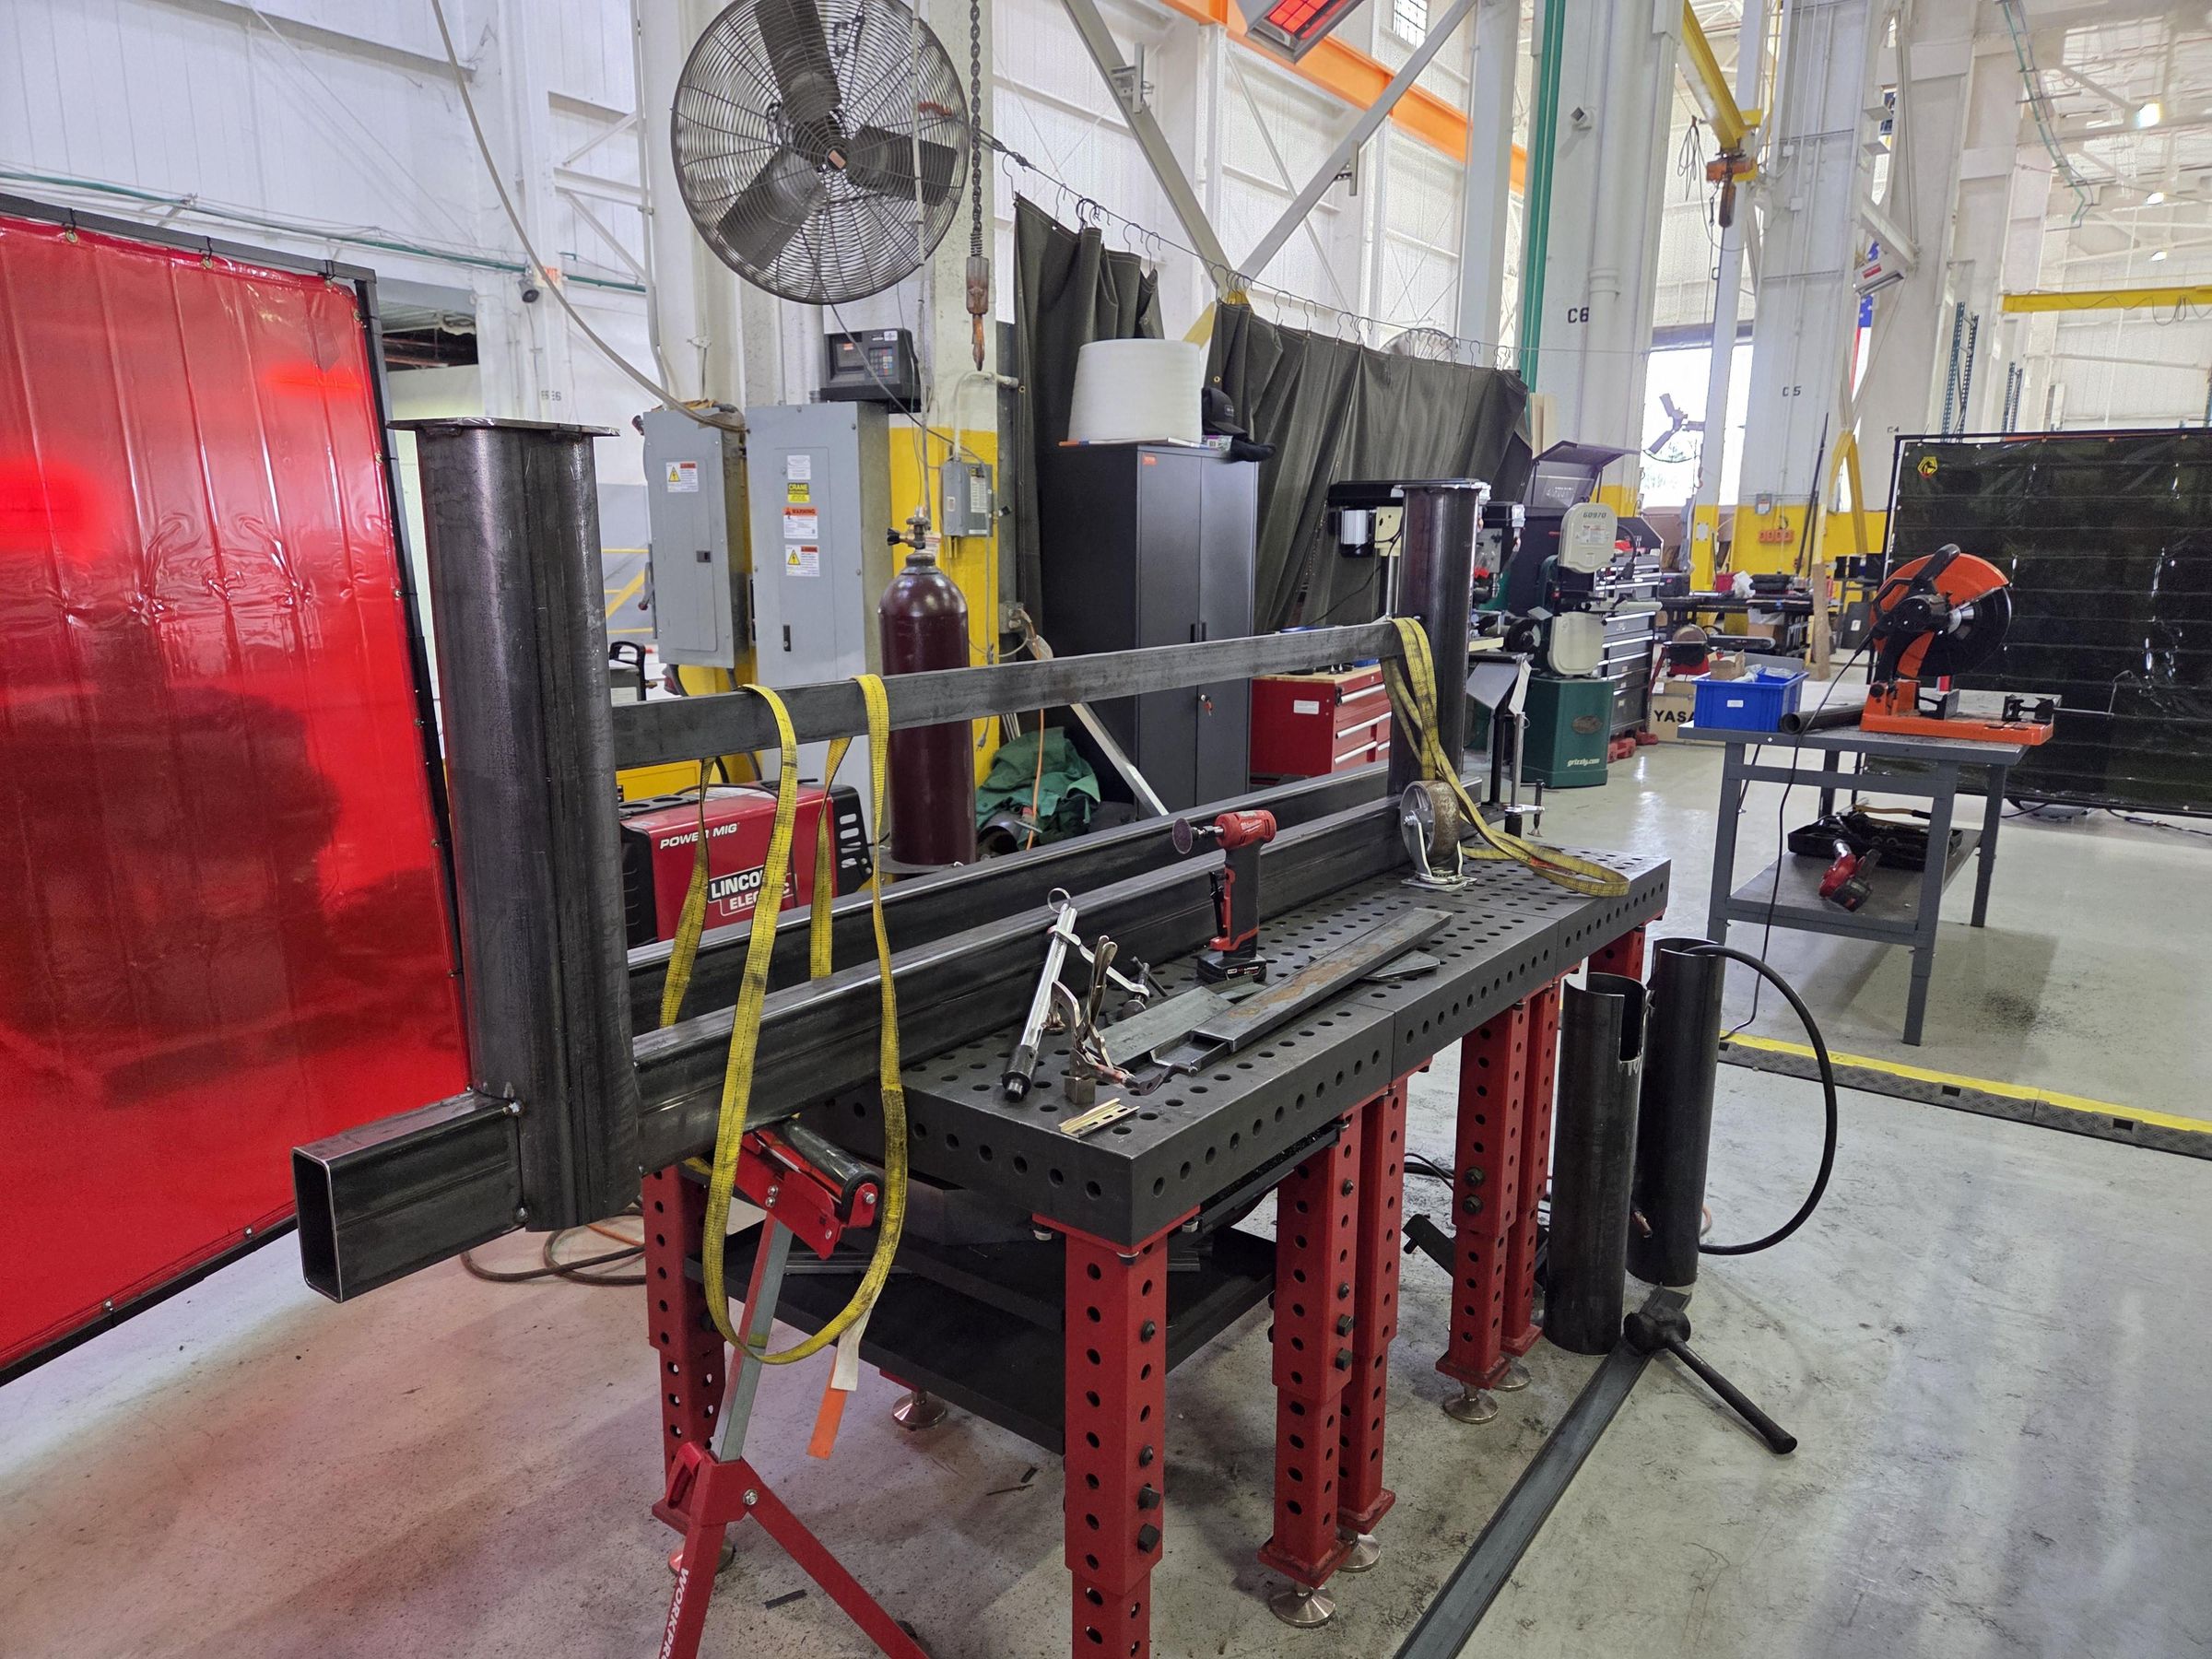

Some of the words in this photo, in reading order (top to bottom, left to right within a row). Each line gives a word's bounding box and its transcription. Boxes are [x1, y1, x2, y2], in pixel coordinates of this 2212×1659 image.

[1568, 307, 1590, 324] C6
[1567, 758, 1601, 767] grizzly.com
[712, 823, 737, 838] MIG
[711, 869, 763, 900] LINCO
